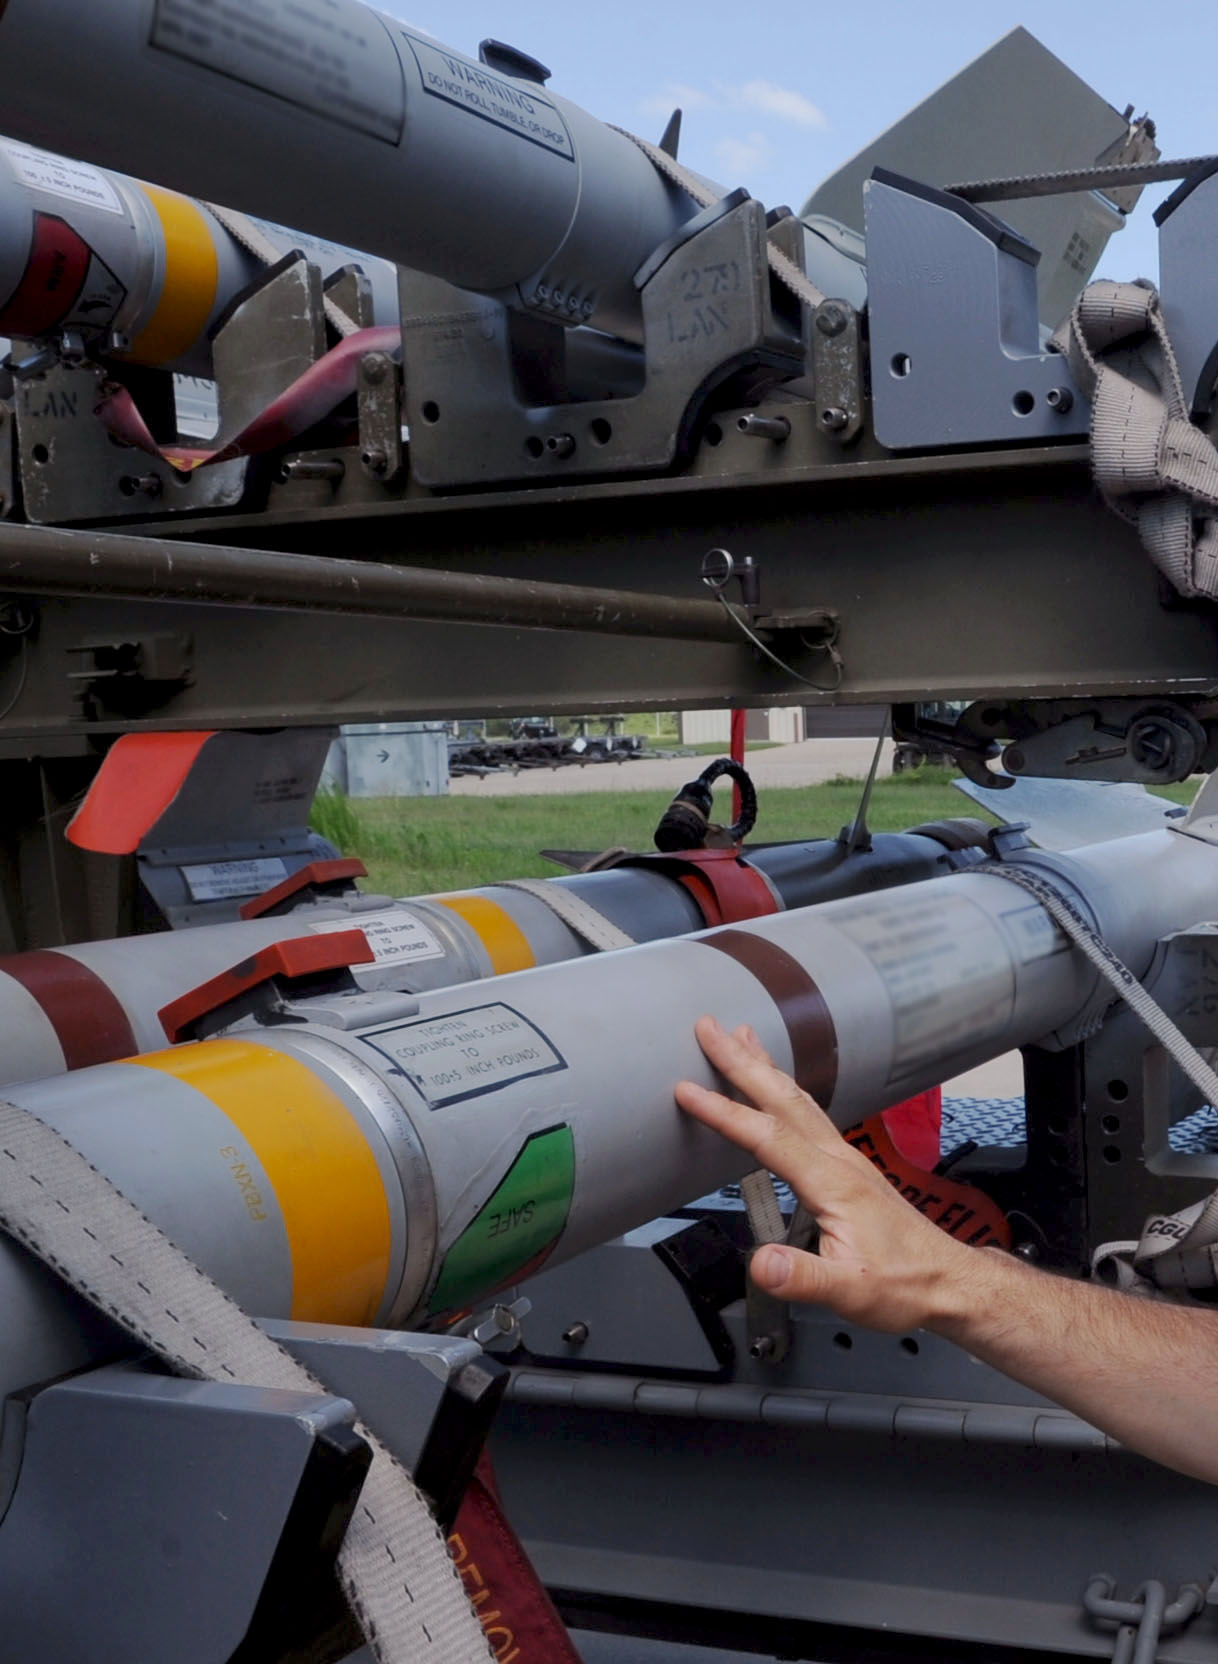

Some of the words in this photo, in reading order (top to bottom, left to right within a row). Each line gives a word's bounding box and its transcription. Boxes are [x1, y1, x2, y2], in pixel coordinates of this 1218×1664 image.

[442, 55, 536, 115] WARNING
[428, 72, 442, 88] DO
[445, 80, 463, 96] NOT
[492, 102, 528, 129] TUMBLE
[544, 127, 565, 145] DROP
[395, 1036, 456, 1060] COUPLING
[456, 1028, 485, 1044] RING
[485, 1020, 522, 1036] SCREW
[418, 1020, 469, 1038] TIGHTEN
[460, 1047, 480, 1059] TO
[466, 1060, 495, 1076] INCH
[497, 1047, 541, 1066] POUNDS
[488, 1199, 536, 1240] SAFE
